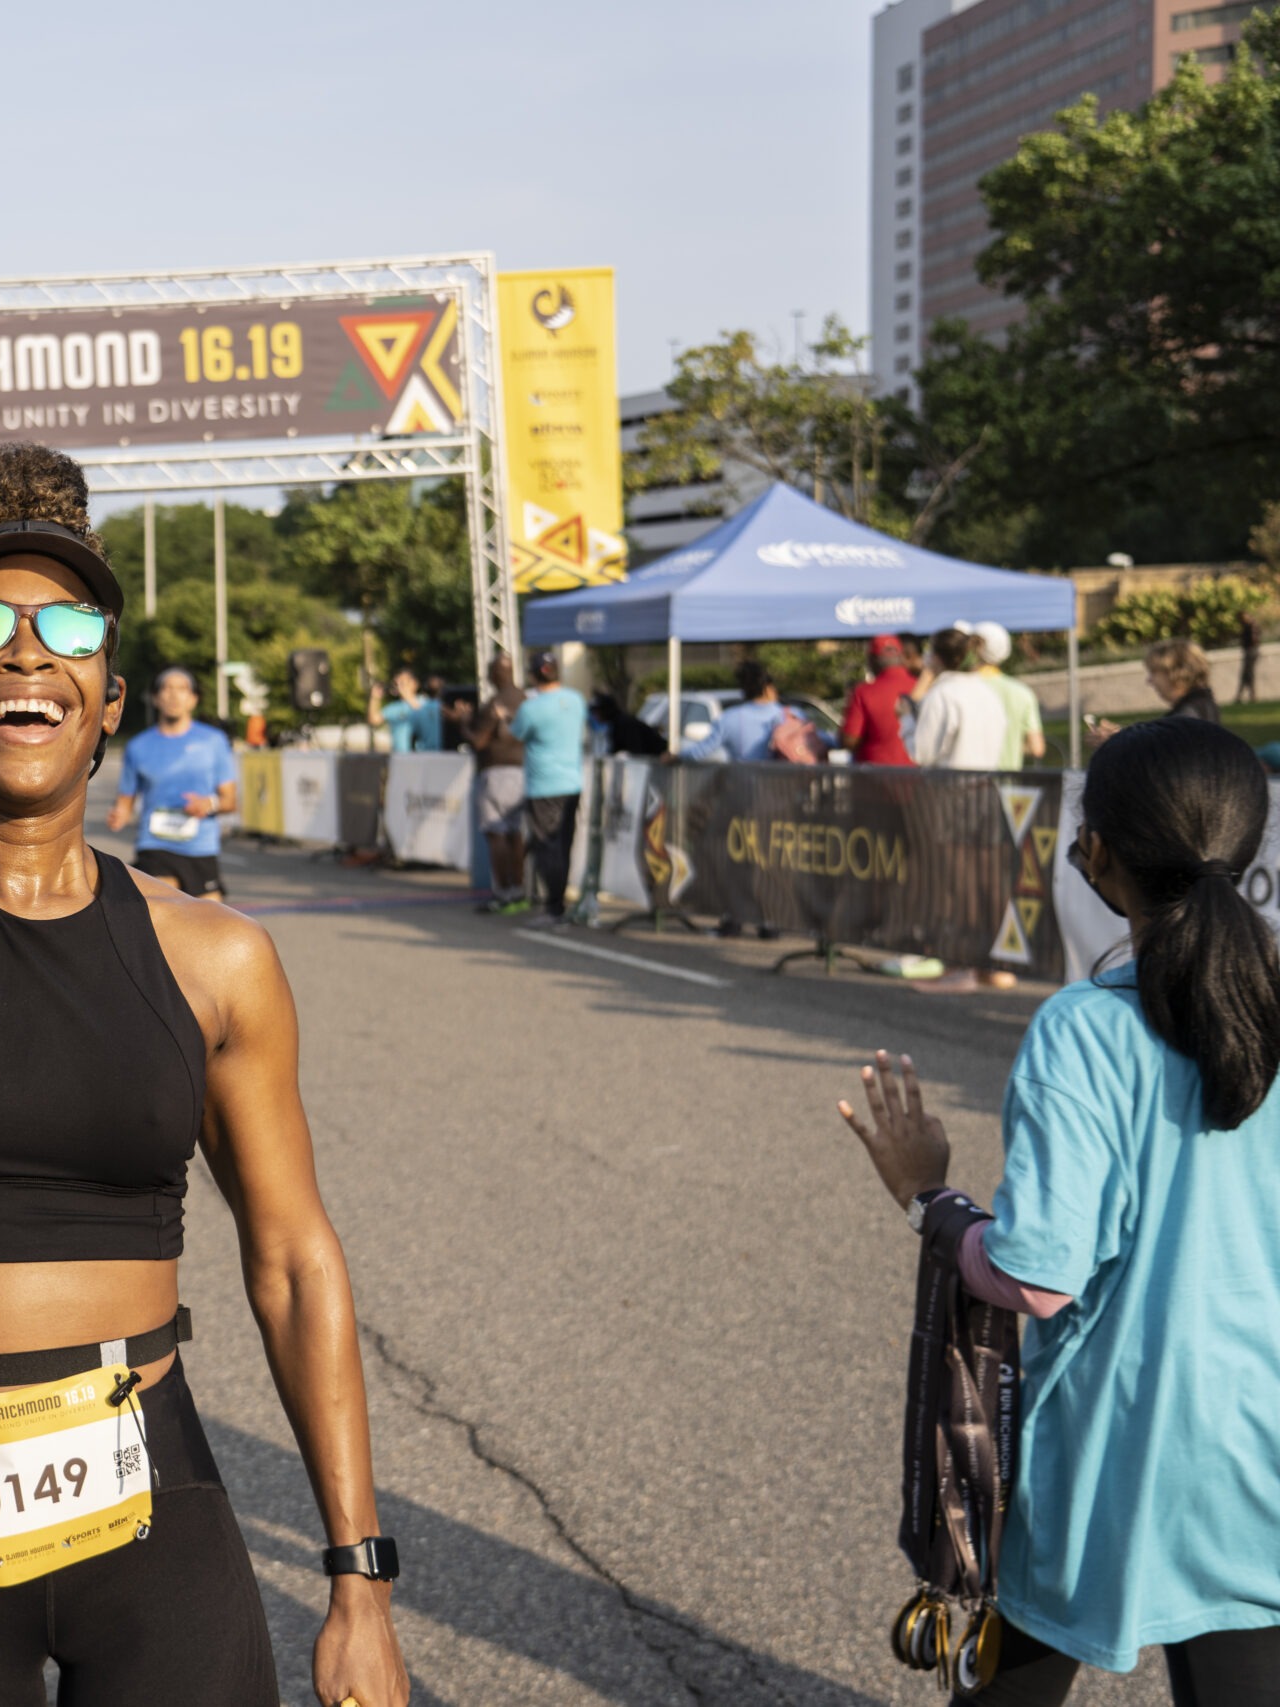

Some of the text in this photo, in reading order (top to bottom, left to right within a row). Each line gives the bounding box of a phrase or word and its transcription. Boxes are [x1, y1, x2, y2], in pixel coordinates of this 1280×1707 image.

[180, 322, 304, 384] 16.19
[2, 403, 87, 431] UNITY
[104, 397, 135, 425] IN
[149, 391, 302, 424] DIVERSITY
[769, 819, 908, 886] FREEDOM
[1000, 1388, 1012, 1411] RUN
[1000, 1414, 1012, 1480] RICHMOND
[72, 1527, 101, 1541] SPORTS
